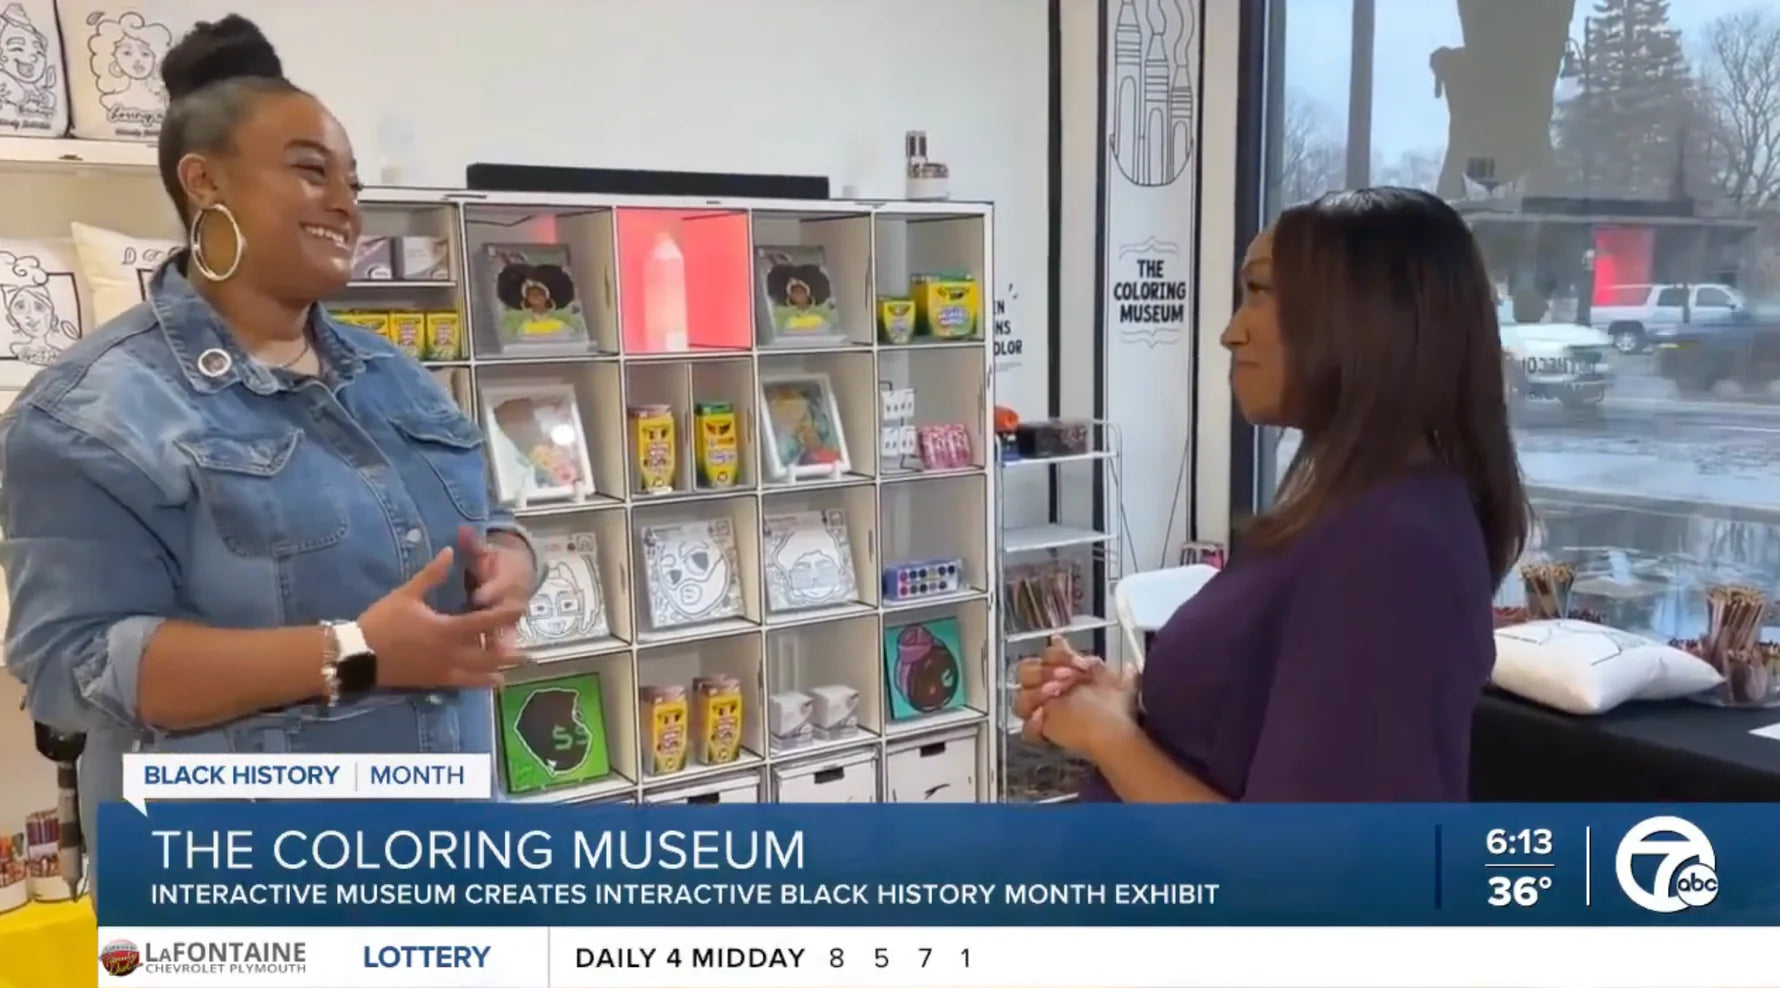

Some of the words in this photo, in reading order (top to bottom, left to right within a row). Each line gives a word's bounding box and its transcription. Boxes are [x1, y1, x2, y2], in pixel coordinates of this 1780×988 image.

[1136, 258, 1164, 279] THE
[1113, 281, 1187, 301] COLORING
[1120, 303, 1184, 323] MUSEUM
